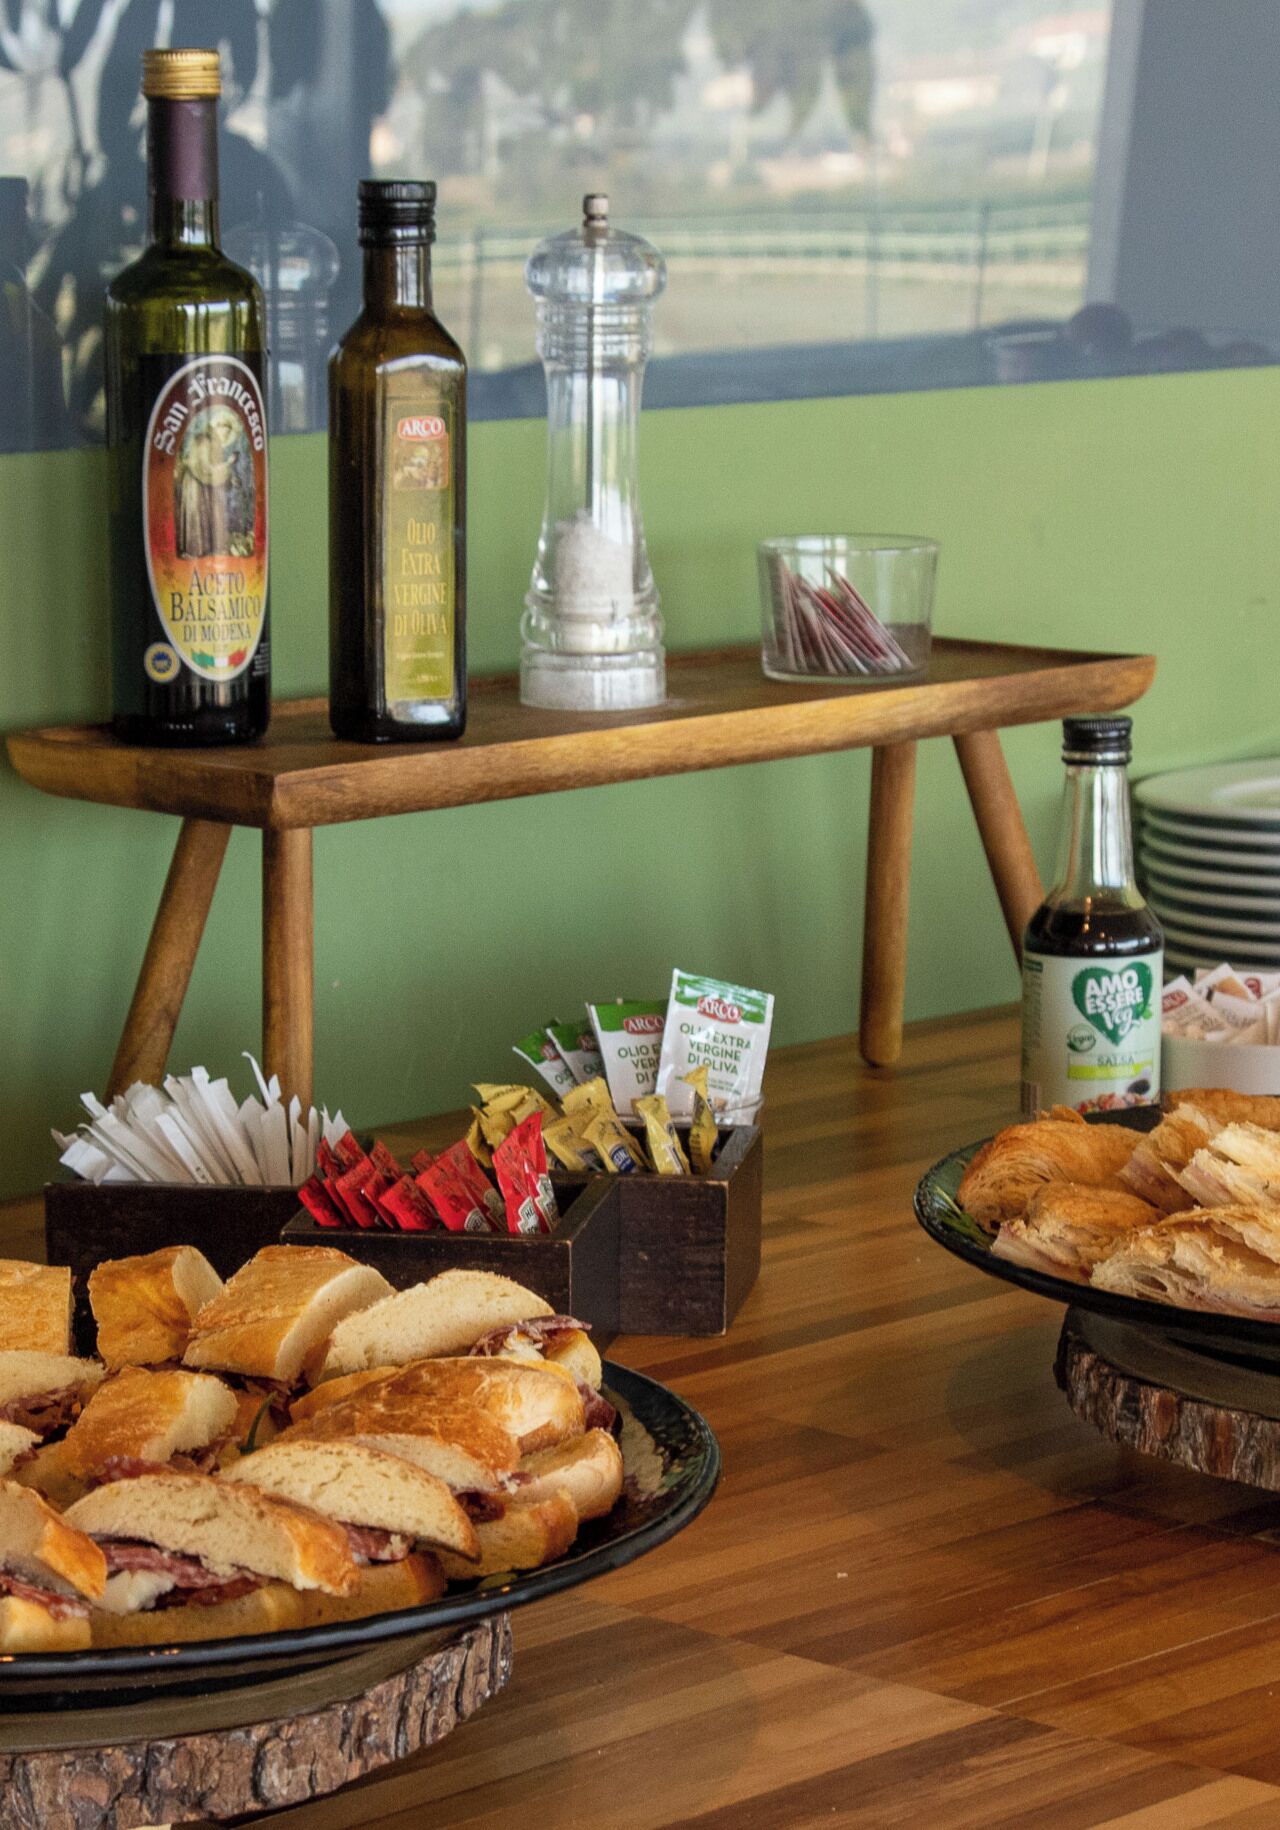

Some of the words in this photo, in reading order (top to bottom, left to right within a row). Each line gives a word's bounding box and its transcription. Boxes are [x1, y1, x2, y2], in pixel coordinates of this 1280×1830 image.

[154, 401, 189, 456] San
[187, 372, 265, 453] Francesco
[401, 419, 443, 438] ARCO
[406, 518, 437, 545] OLIO
[400, 546, 442, 577] EXTRA
[188, 567, 246, 597] ACETO
[394, 580, 448, 608] VERGINE
[169, 590, 261, 624] BALSAMICO
[183, 624, 198, 642] DI
[200, 620, 252, 643] MODENA
[394, 612, 410, 637] DI
[411, 610, 448, 637] OLIVA
[1086, 969, 1138, 996] AMO
[700, 997, 739, 1020] ARCO
[1086, 987, 1144, 1016] ESSERE
[627, 1015, 664, 1032] ARCO
[618, 1045, 649, 1058] OLIO
[688, 1039, 742, 1062] VERGINE
[712, 1030, 752, 1050] EXTRA
[687, 1053, 700, 1065] DI
[702, 1057, 739, 1075] OLIVA
[635, 1072, 650, 1084] DI
